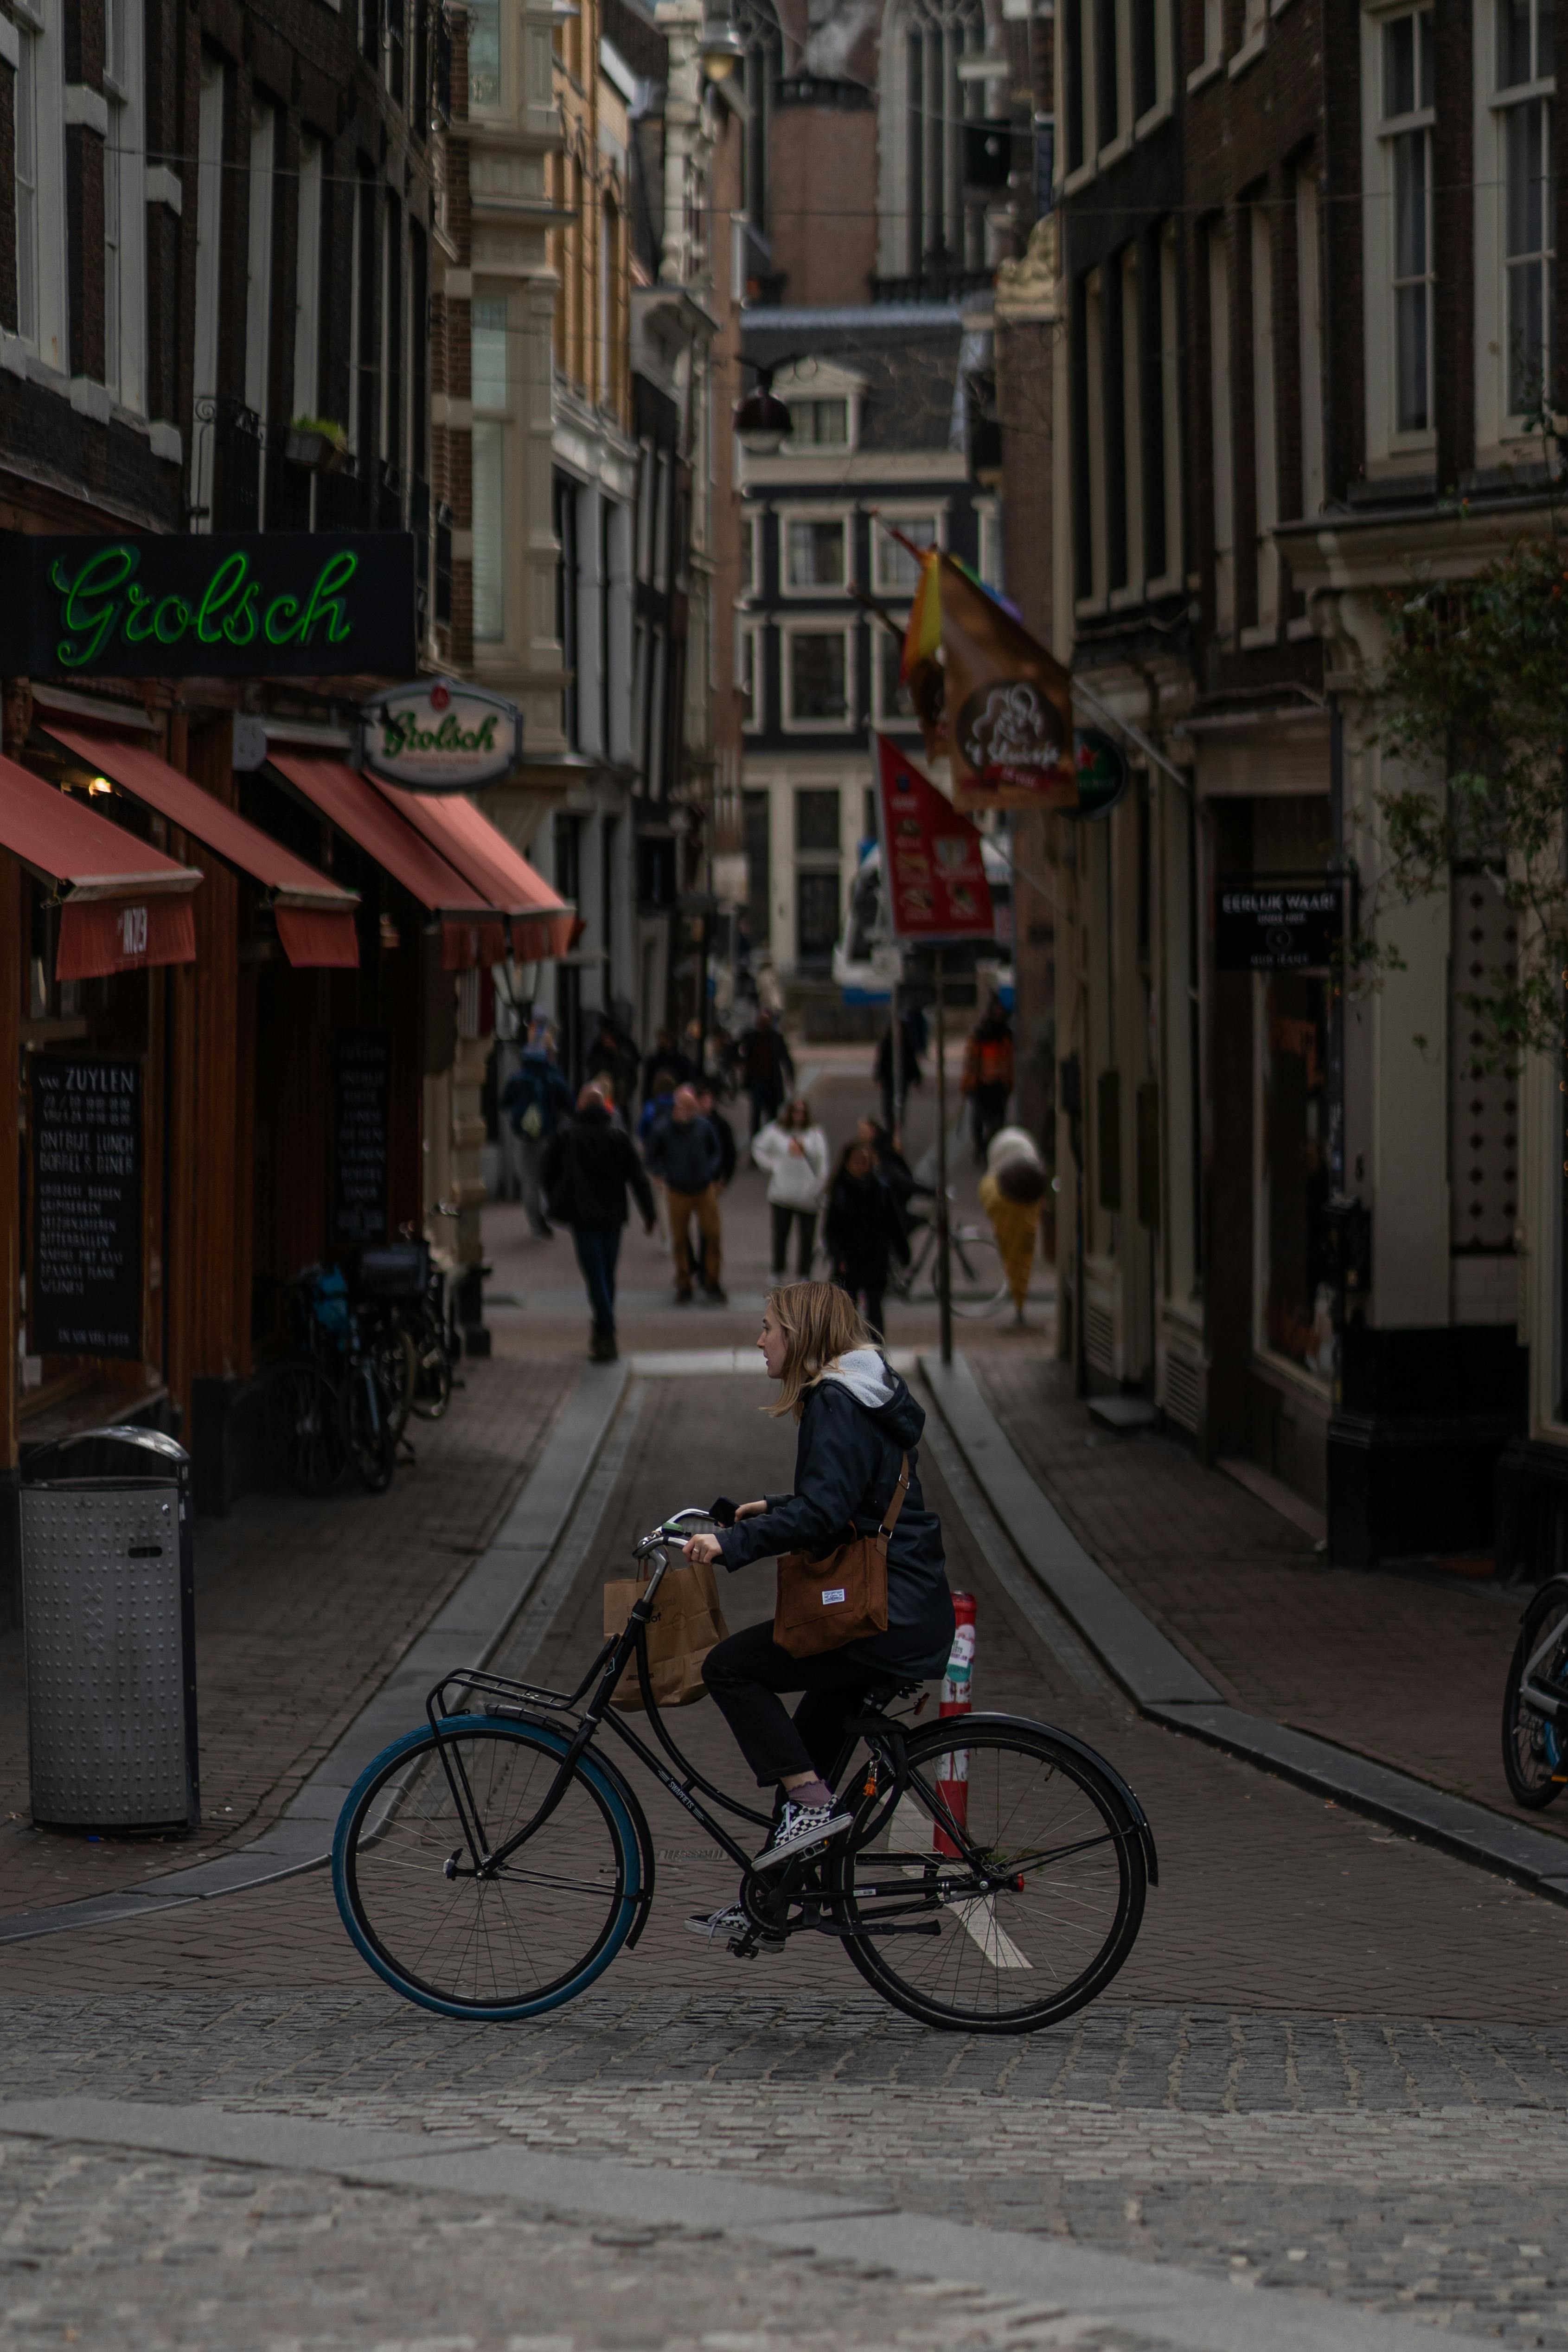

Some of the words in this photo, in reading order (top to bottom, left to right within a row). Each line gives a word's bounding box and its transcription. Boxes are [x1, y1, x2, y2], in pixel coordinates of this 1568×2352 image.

[48, 544, 358, 667] Grolsch
[382, 711, 498, 758] Grolsch
[65, 1066, 134, 1094] ZUYLEN
[668, 1781, 694, 1809] SWAPFIETS
